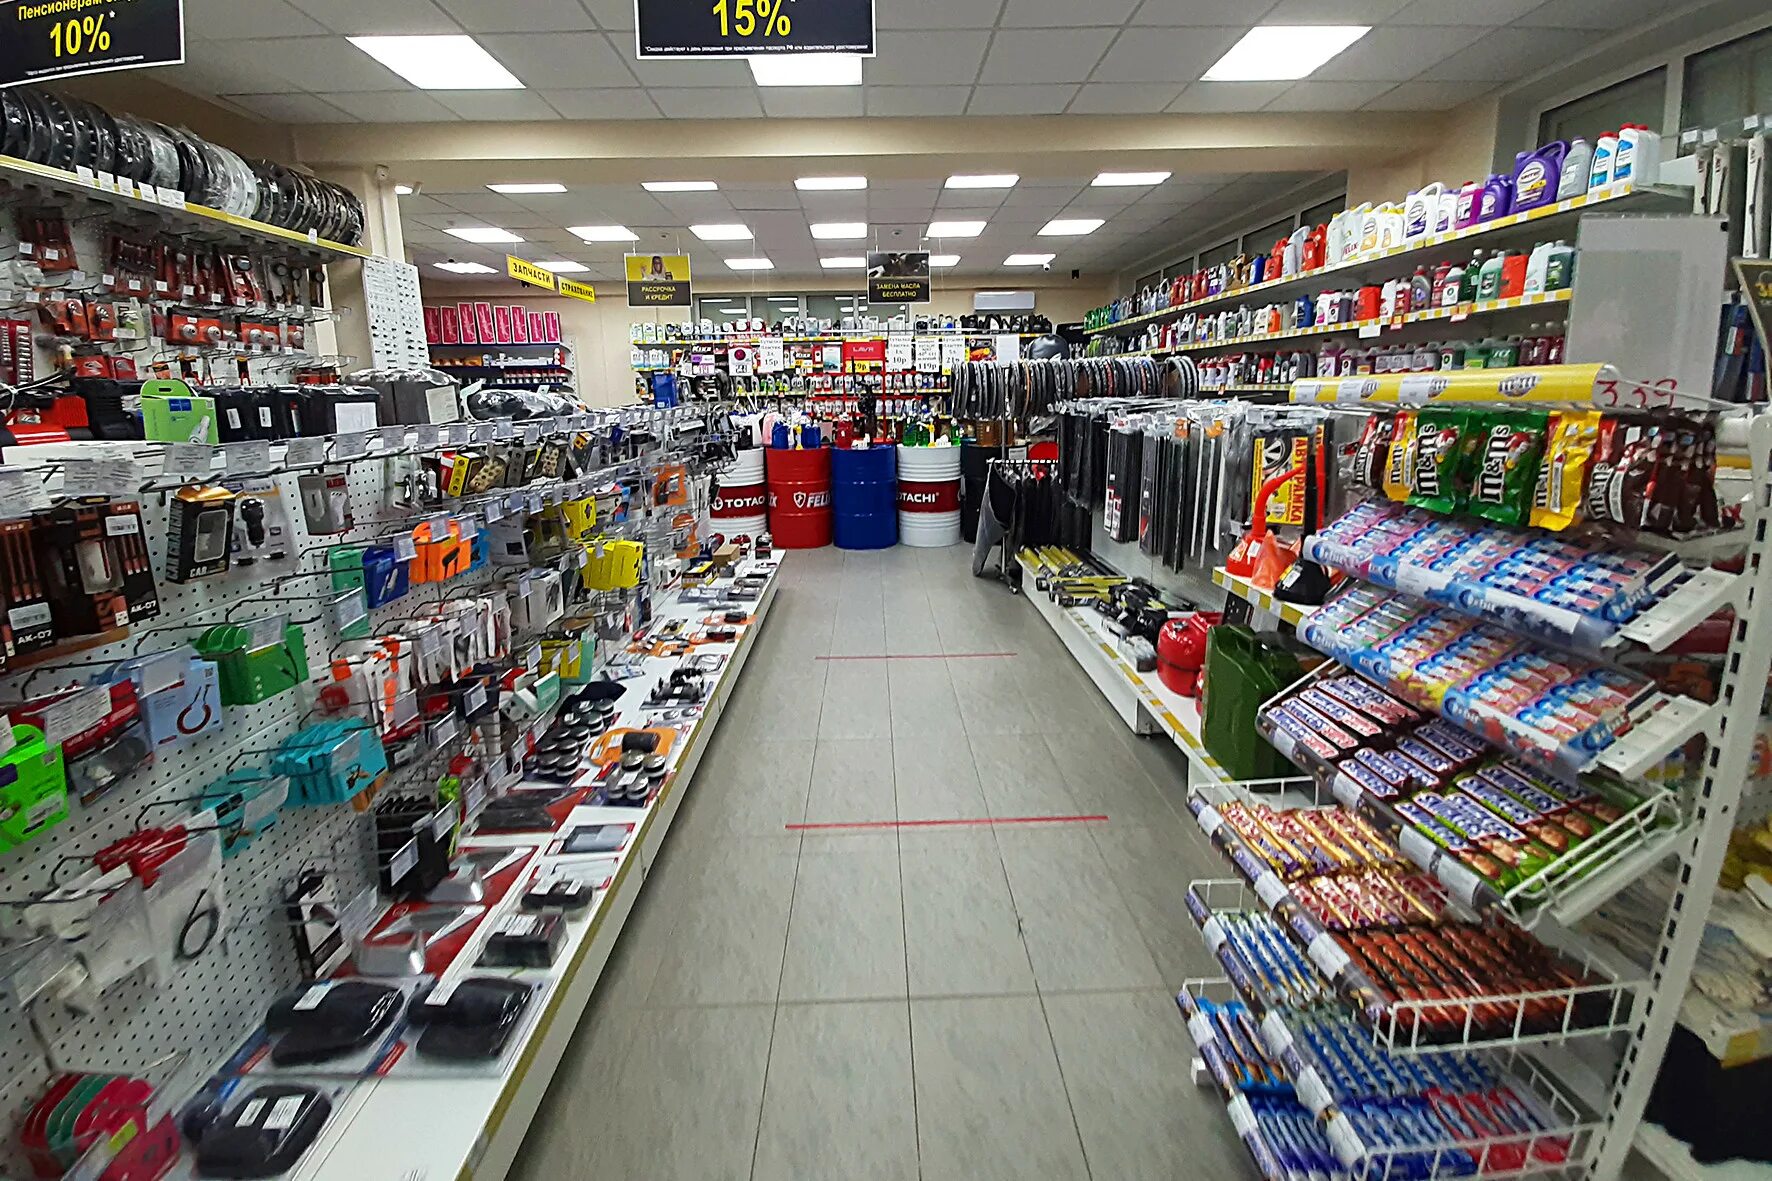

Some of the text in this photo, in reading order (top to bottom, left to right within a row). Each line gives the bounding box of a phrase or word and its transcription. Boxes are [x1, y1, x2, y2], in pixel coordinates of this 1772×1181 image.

[713, 0, 791, 37] 15%
[50, 13, 111, 57] 10%
[513, 262, 551, 283] ЗАПЧАСТИ
[17, 629, 52, 645] AK-07
